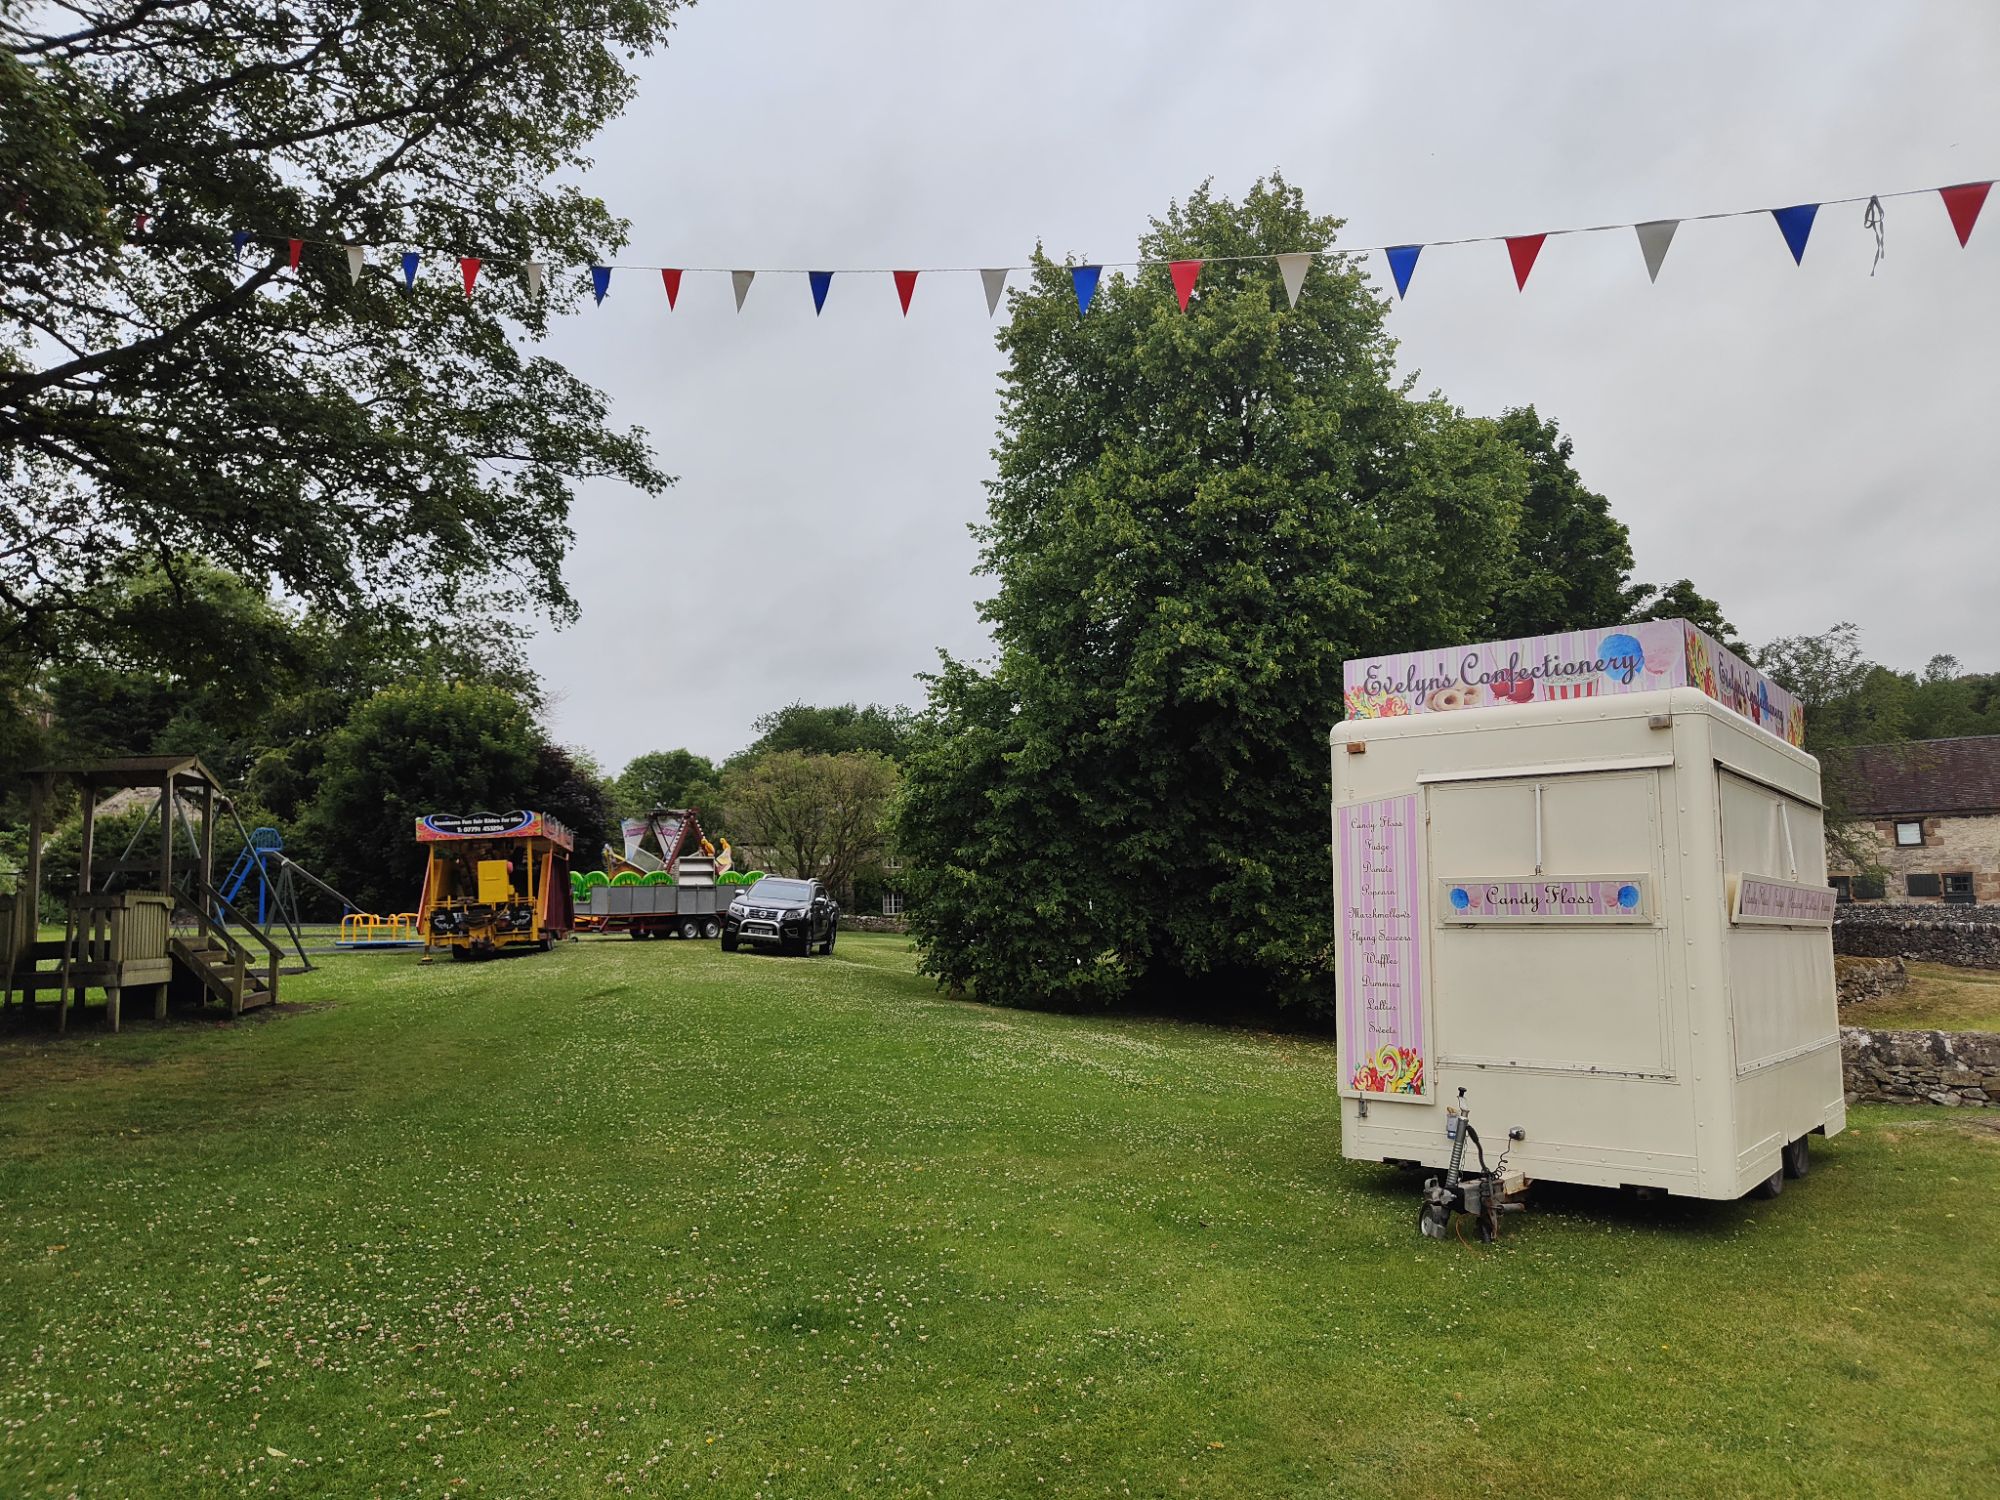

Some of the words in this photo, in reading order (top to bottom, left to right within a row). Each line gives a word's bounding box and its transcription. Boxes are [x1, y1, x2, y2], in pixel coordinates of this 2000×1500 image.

[1363, 663, 1458, 705] Evelyn's
[1460, 652, 1642, 694] Confectionery
[1351, 818, 1377, 832] Candy
[1379, 816, 1403, 828] Floss
[1364, 838, 1390, 855] Fudge
[1361, 883, 1396, 899] Popcorn
[1486, 886, 1543, 912] Candy
[1545, 885, 1595, 905] Floss
[1349, 929, 1376, 945] Flying
[1378, 928, 1411, 942] Saucers
[1362, 952, 1399, 968] Waffles
[1362, 975, 1401, 988] Dummies
[1366, 998, 1397, 1011] Lollies
[1368, 1021, 1397, 1034] Sweets
